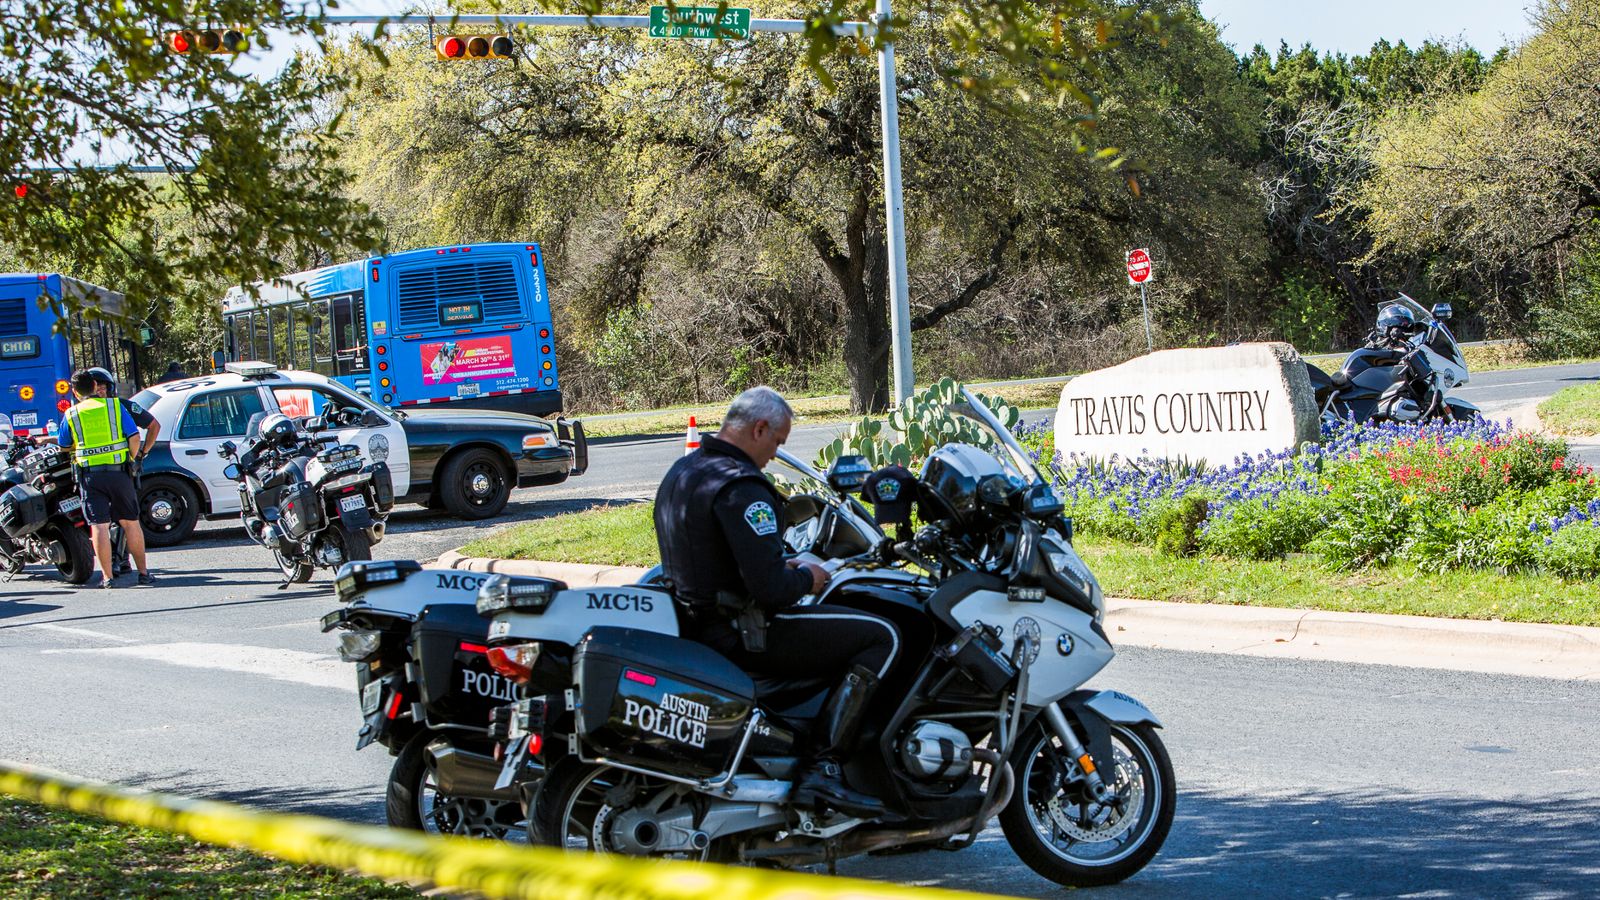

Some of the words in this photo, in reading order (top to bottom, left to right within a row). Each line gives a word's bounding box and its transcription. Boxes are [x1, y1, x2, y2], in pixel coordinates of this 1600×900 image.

[688, 27, 711, 37] PKWY
[532, 268, 542, 303] 2230
[456, 357, 480, 366] MARCH
[1070, 394, 1147, 436] TRAVIS
[1153, 389, 1271, 434] COUNTRY
[82, 446, 115, 456] POLICE
[586, 592, 654, 613] MC15
[462, 668, 525, 702] POLIC
[659, 692, 710, 723] AUSTIN
[622, 699, 707, 749] POLICE
